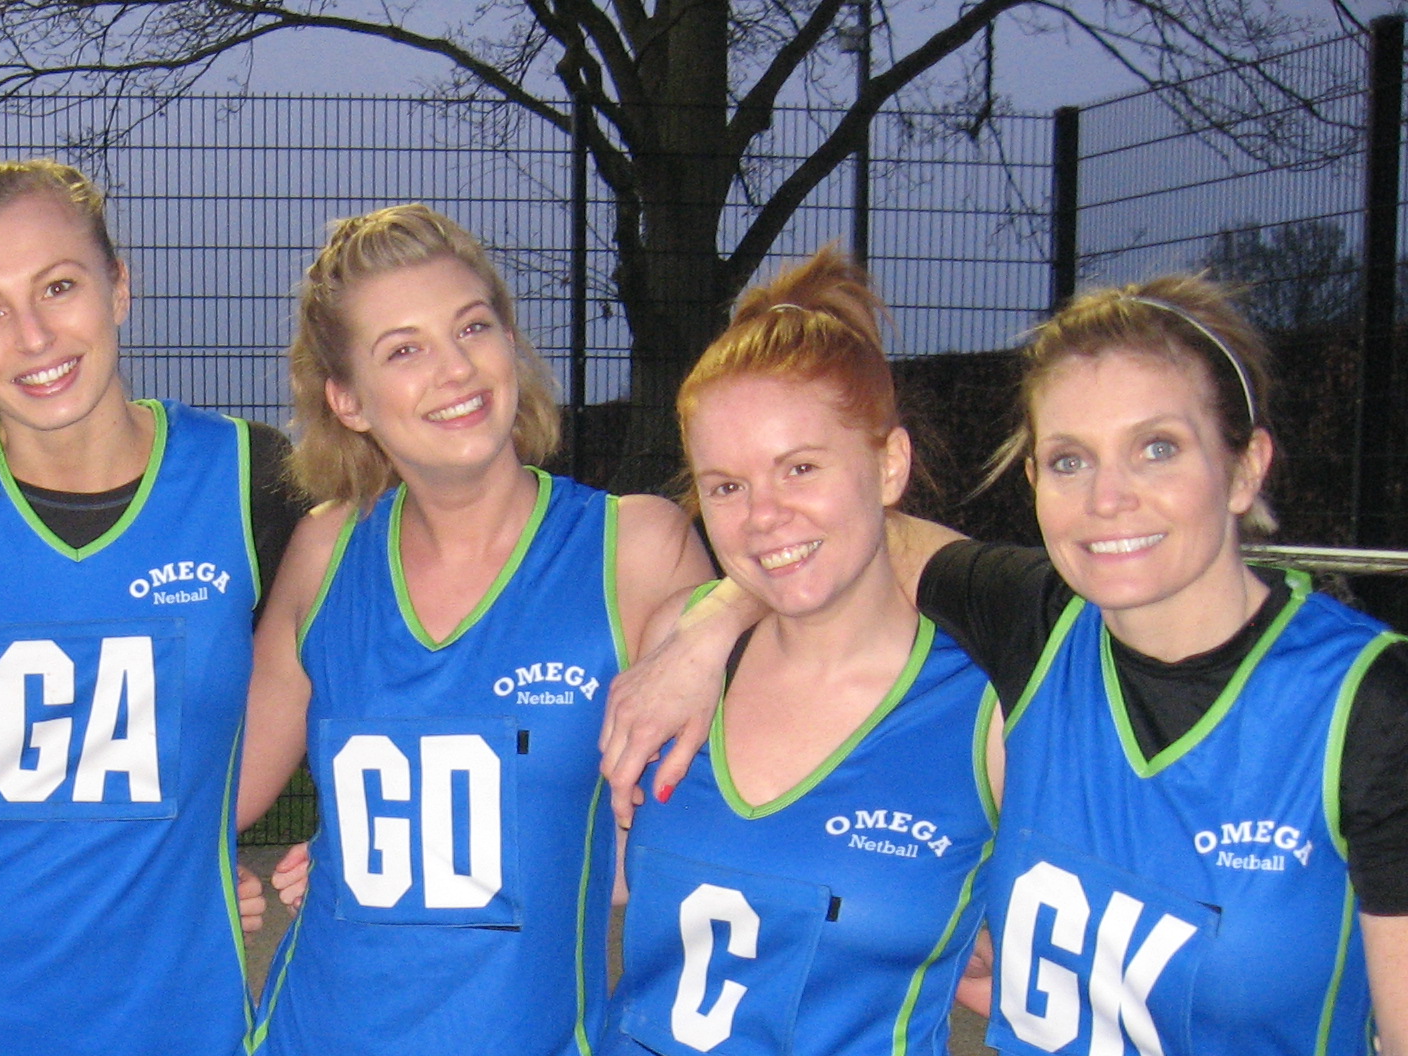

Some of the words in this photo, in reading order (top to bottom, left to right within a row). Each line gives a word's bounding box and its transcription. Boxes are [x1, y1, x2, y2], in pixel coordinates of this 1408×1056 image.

[129, 561, 231, 599] OMEGA
[153, 586, 208, 605] Netball
[493, 662, 600, 701] OMEGA
[516, 691, 574, 705] Netball
[332, 734, 503, 909] GD
[825, 809, 952, 858] OMEGA
[848, 833, 919, 858] Netball
[1194, 820, 1313, 866] OMEGA
[1215, 850, 1285, 871] Netball
[671, 883, 760, 1053] C
